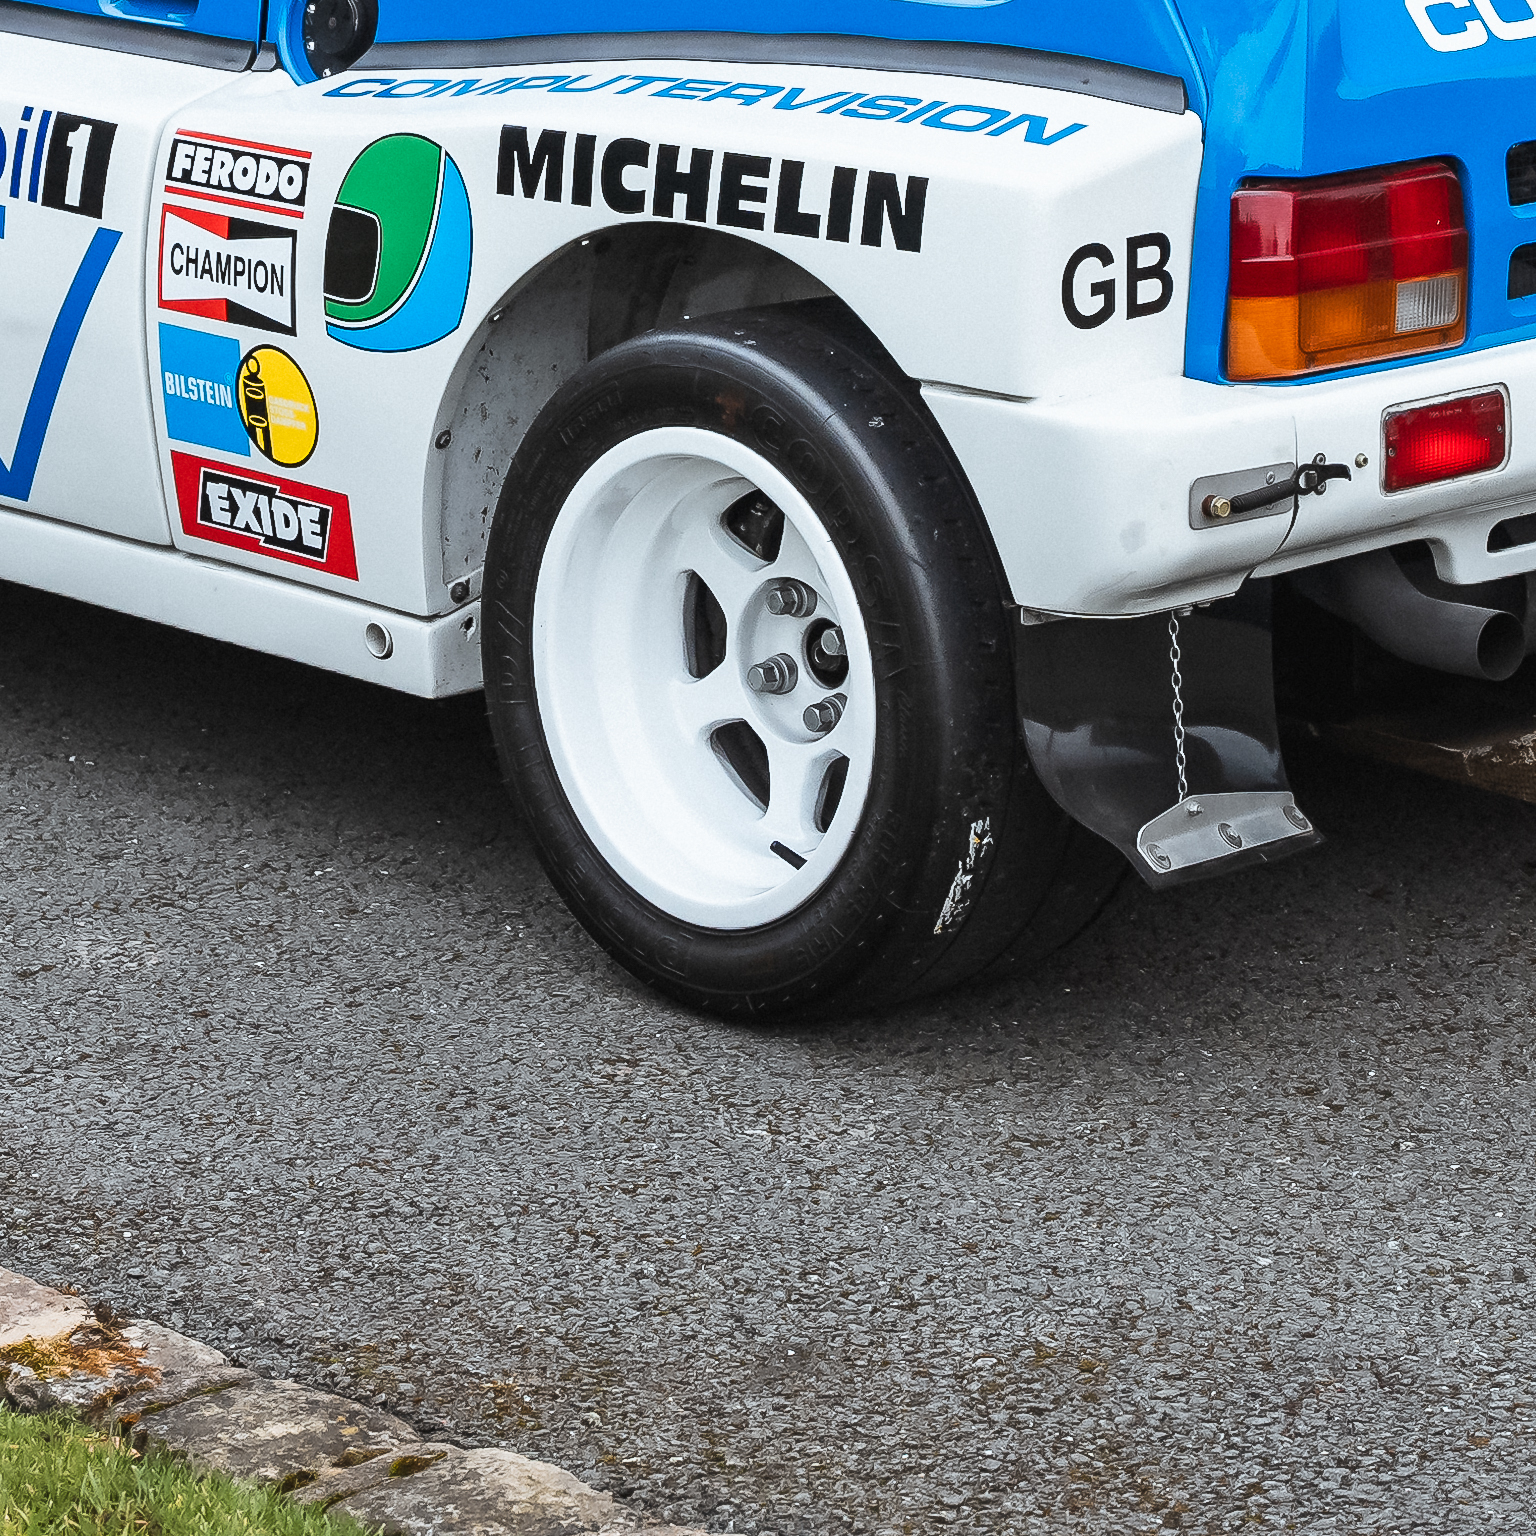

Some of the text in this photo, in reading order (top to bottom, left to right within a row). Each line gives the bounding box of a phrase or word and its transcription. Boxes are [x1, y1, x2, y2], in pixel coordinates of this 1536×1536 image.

[322, 74, 1089, 146] COMPUTERVISION
[171, 142, 303, 200] FERODO
[496, 123, 930, 254] MICHELIN
[170, 242, 285, 298] CHAMPION
[1061, 231, 1174, 330] GB
[164, 371, 233, 409] BILSTEIN
[205, 481, 323, 550] EXIDE
